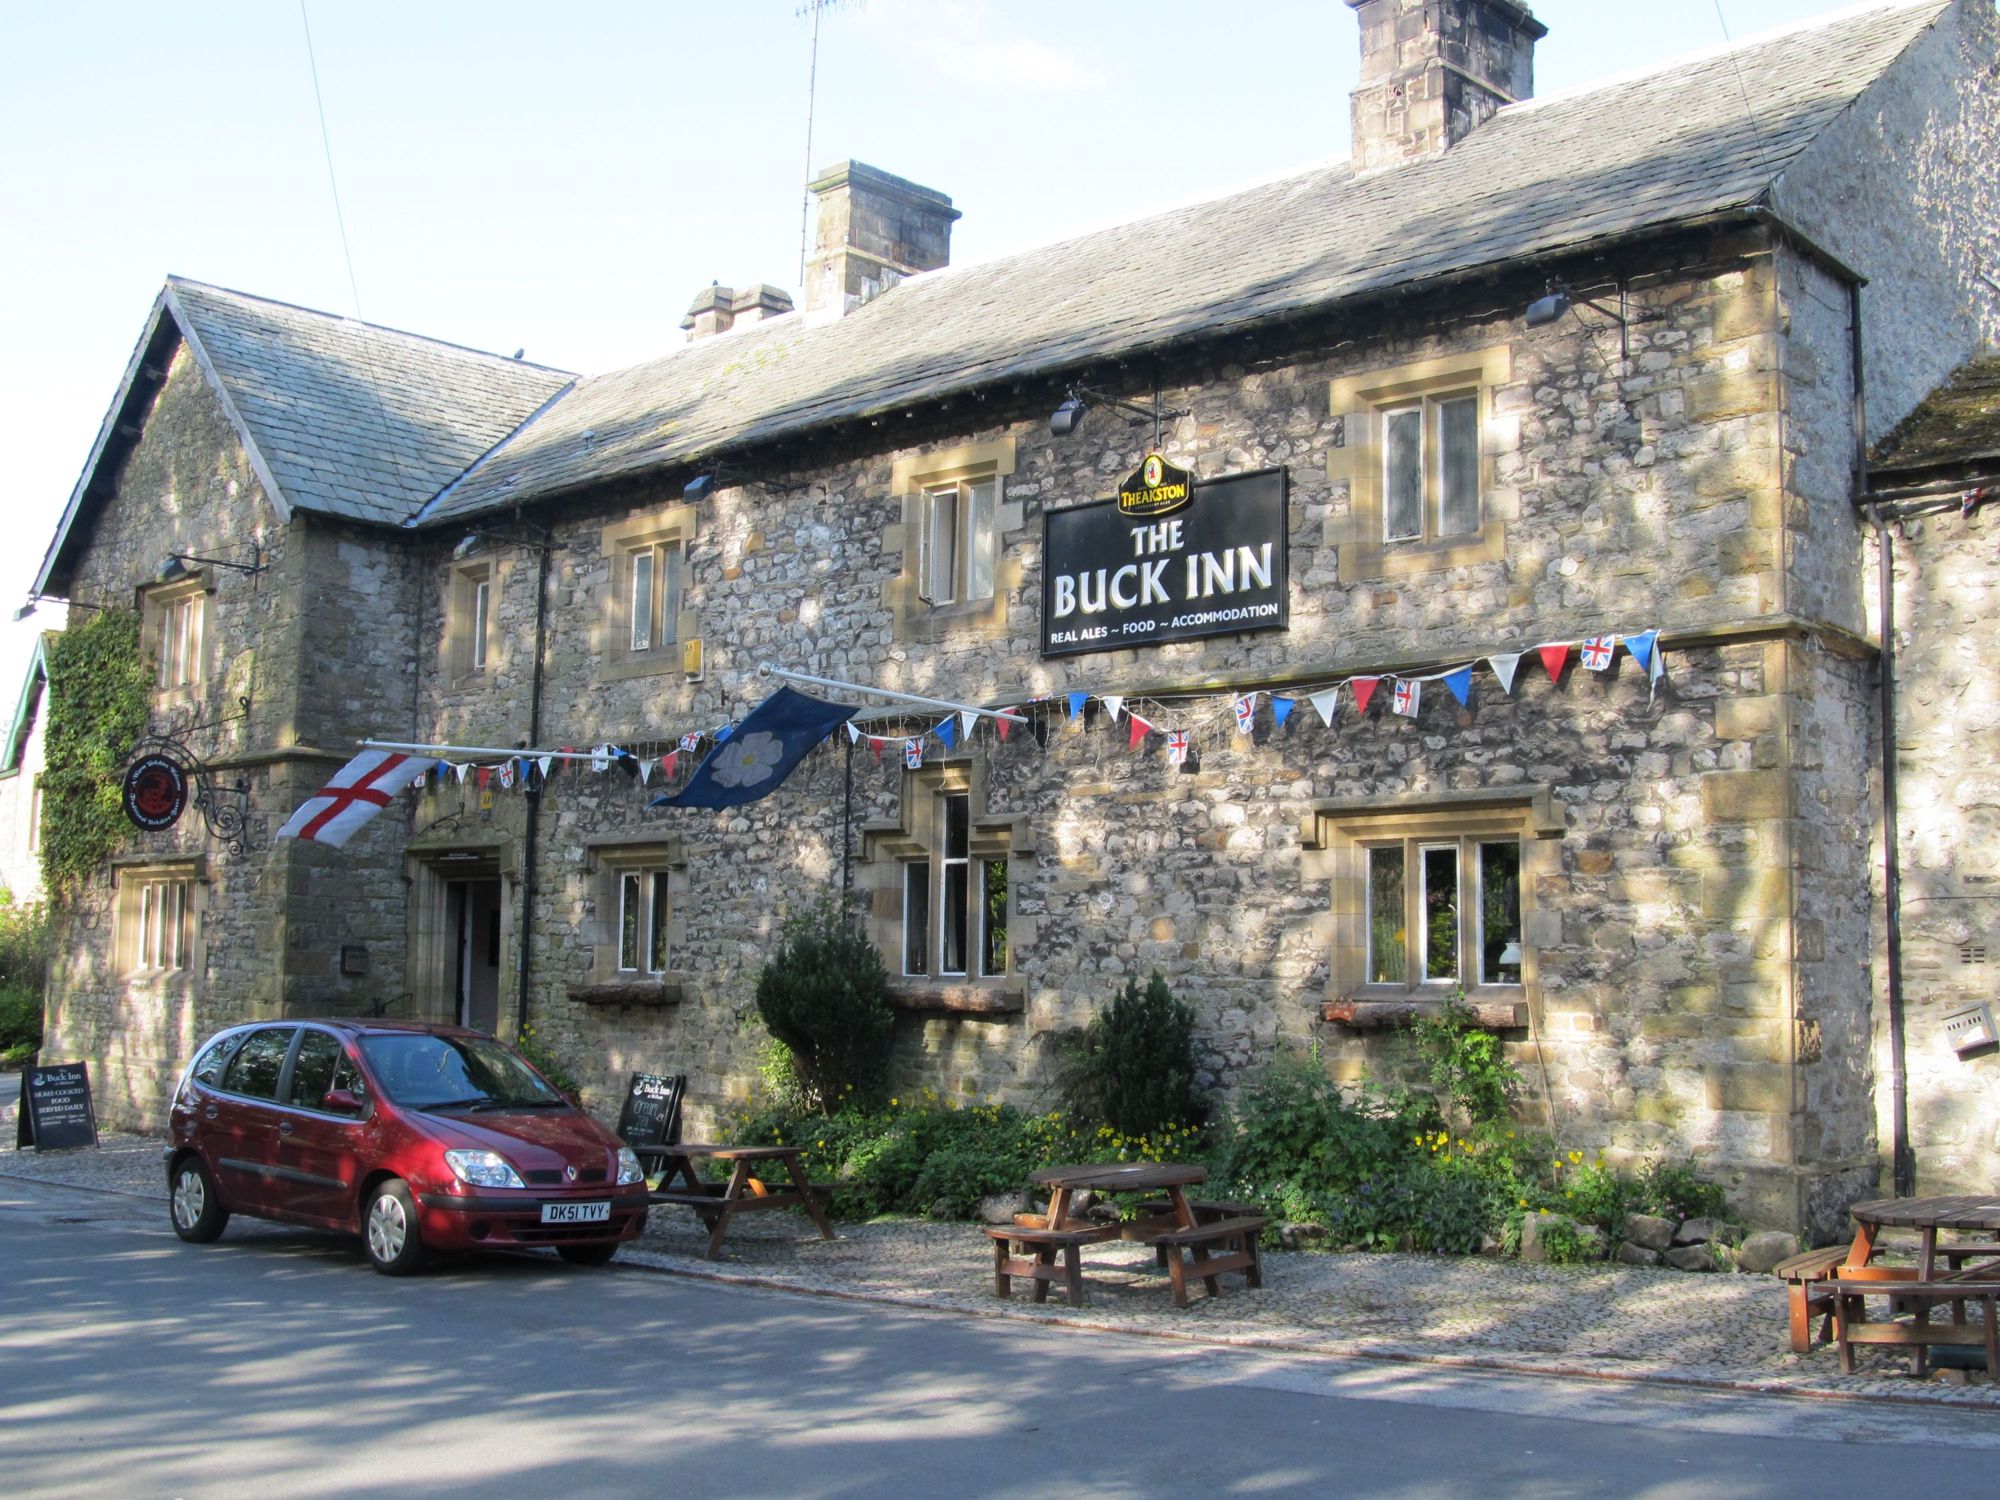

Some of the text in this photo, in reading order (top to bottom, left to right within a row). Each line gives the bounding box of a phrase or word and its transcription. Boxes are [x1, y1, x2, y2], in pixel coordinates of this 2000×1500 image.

[1121, 484, 1184, 507] THEAKSTON
[1130, 520, 1184, 557] THE
[1054, 542, 1273, 619] BUCK INN
[1051, 630, 1078, 644] REAL
[1080, 626, 1108, 640] ALES
[1123, 620, 1155, 634] FOOD
[1171, 603, 1278, 628] ACCOMMODATION
[47, 1072, 81, 1082] Buck Inn
[55, 1088, 84, 1096] COOKED
[644, 1083, 670, 1095] Buck Inn
[38, 1103, 84, 1114] SERVED DAILY
